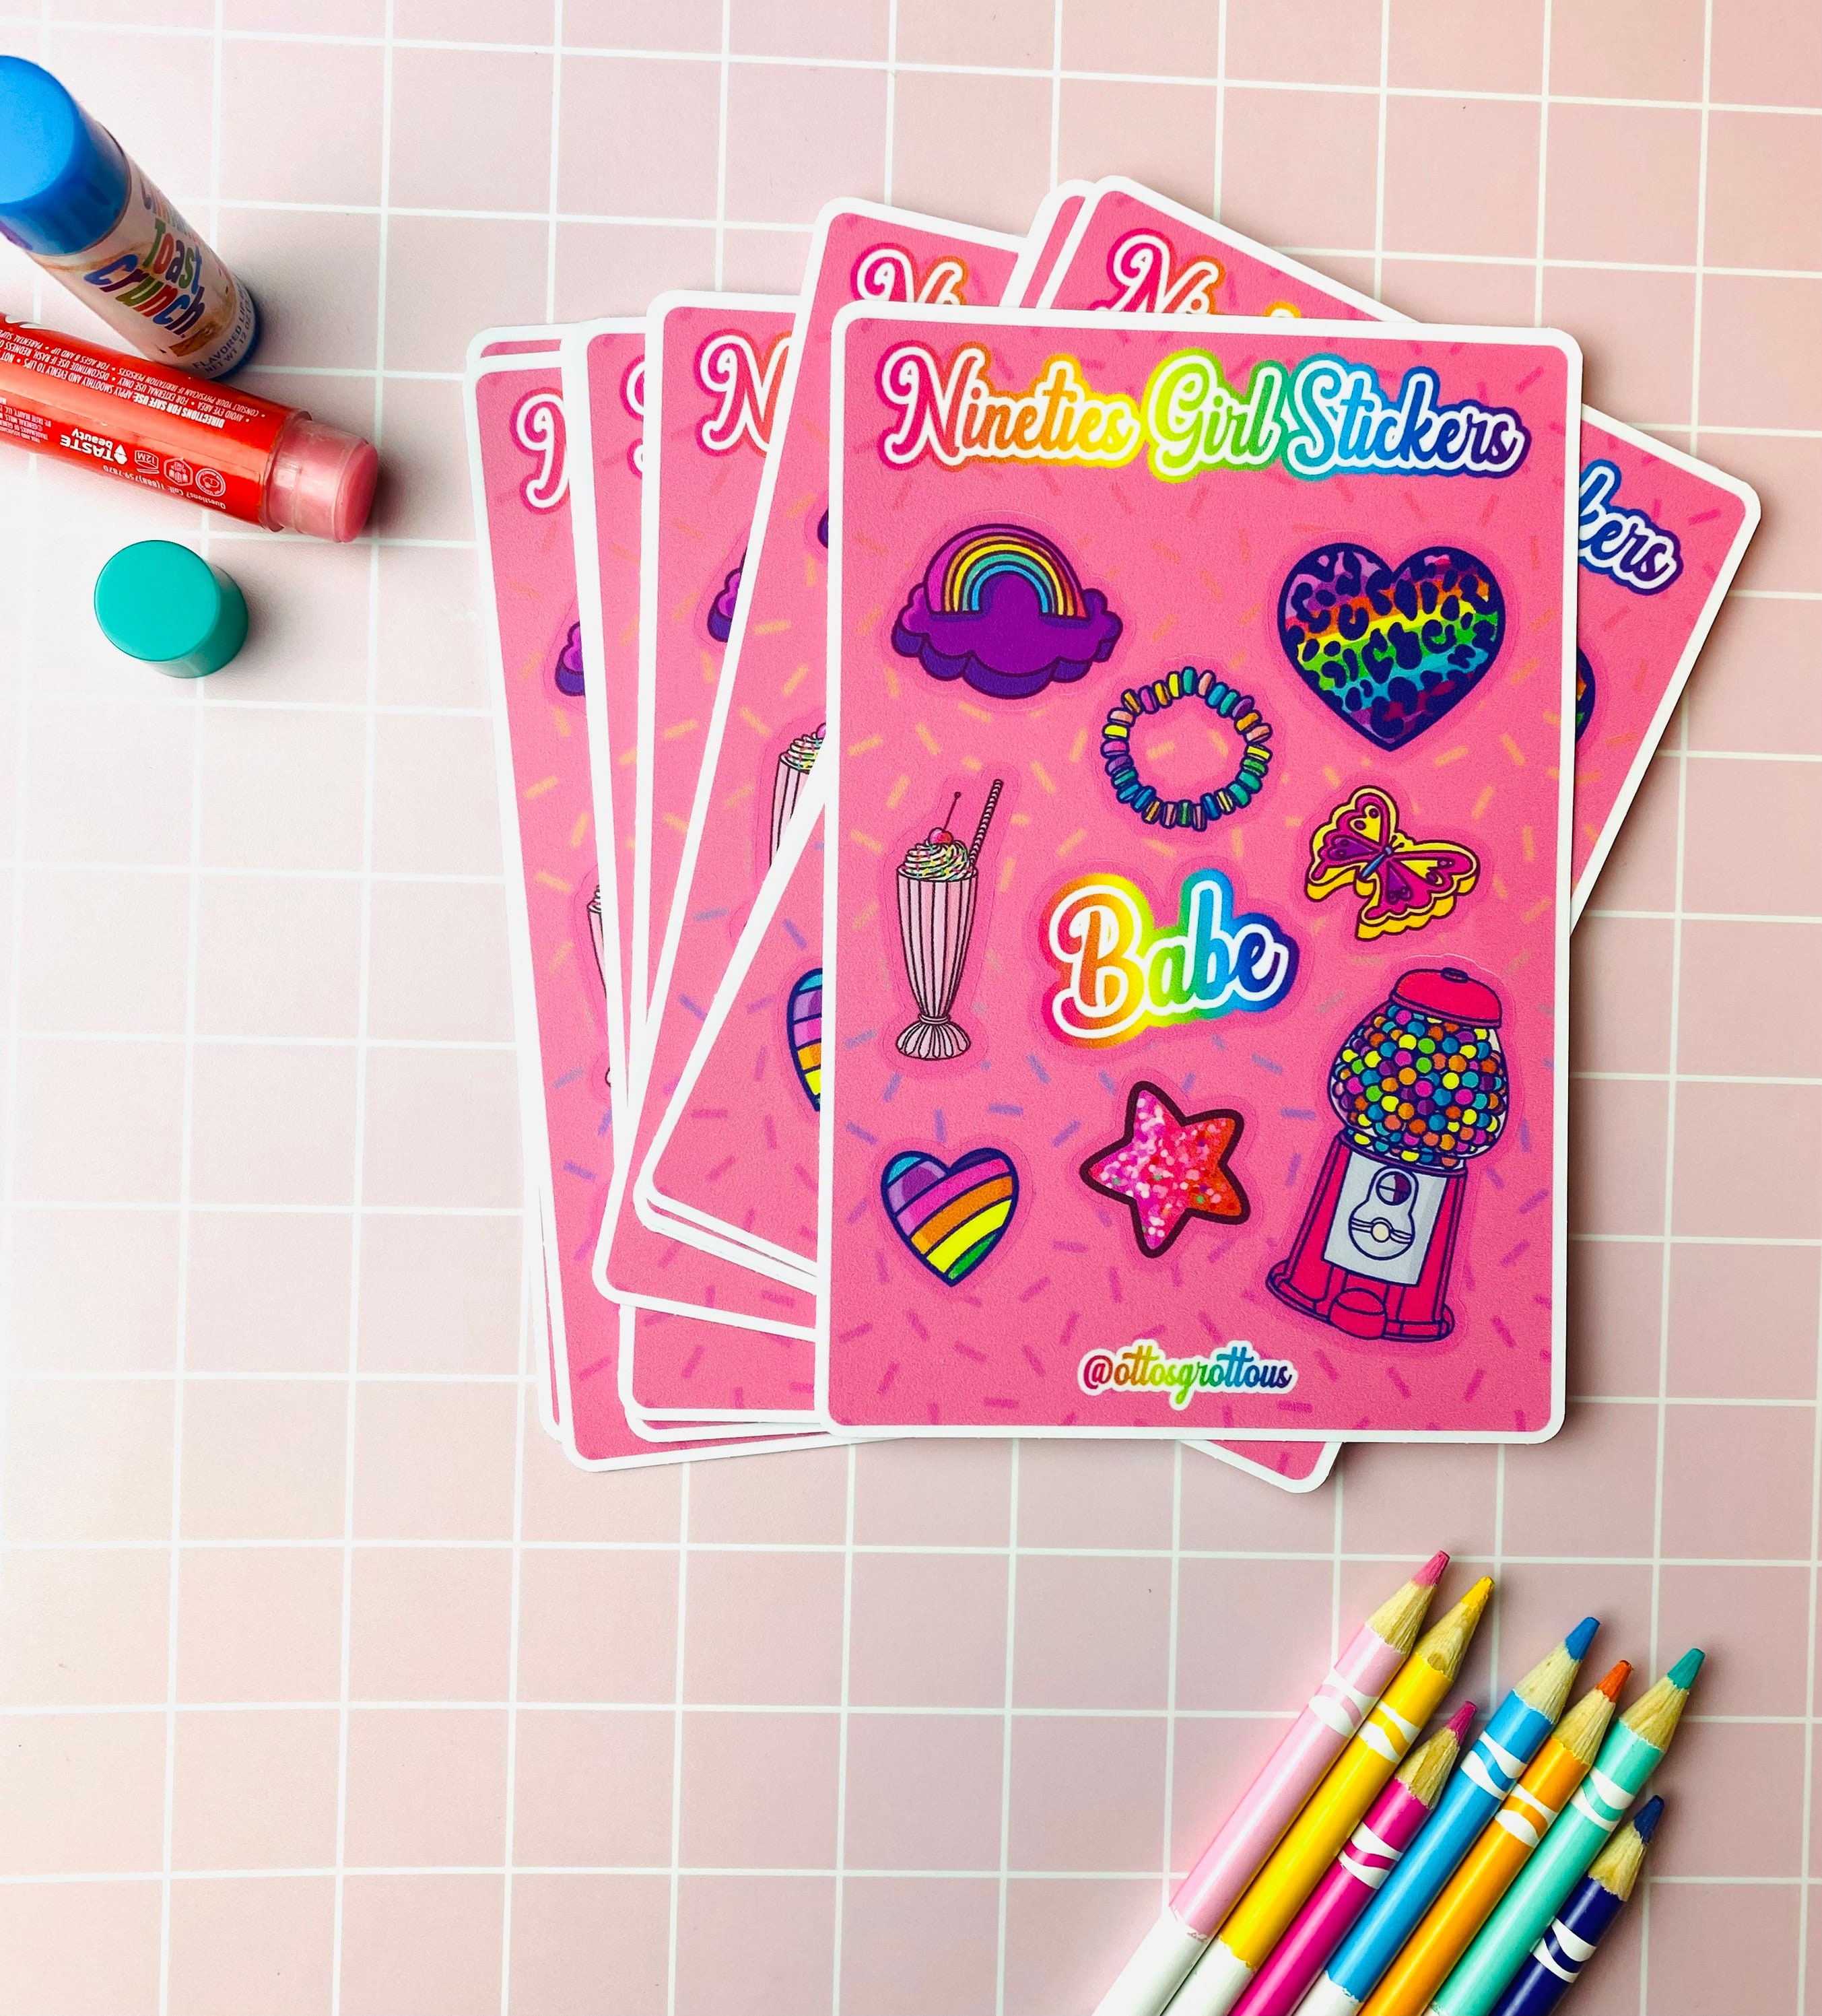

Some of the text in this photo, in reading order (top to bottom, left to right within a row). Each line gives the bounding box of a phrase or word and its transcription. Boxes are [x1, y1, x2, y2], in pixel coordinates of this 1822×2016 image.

[143, 217, 202, 294] Toast
[83, 253, 205, 335] Crunch
[13, 335, 43, 349] PARENTAL
[192, 325, 242, 368] FLAVORED
[4, 342, 32, 356] REDNESS
[33, 349, 50, 362] RASH,
[61, 350, 75, 359] AND
[23, 358, 37, 370] LIPS
[49, 356, 58, 364] IF
[57, 358, 70, 368] USE
[80, 356, 97, 366] AGES
[96, 361, 110, 370] FOR
[36, 363, 46, 373] TO
[46, 366, 68, 379] EVENLY
[70, 362, 109, 380] DISCONTINUE
[118, 368, 145, 381] PERSISTS
[68, 372, 82, 383] AND
[117, 378, 134, 388] ONLY
[145, 377, 178, 391] IRRITATION
[81, 377, 114, 393] SMOOTHLY
[134, 382, 147, 393] USE
[113, 387, 133, 399] APPLY
[147, 386, 176, 401] EXTERNAL
[184, 389, 215, 403] PHYSICIAN
[148, 397, 167, 410] SAFE
[176, 395, 189, 405] FOR
[215, 399, 232, 408] YOUR
[166, 403, 182, 415] FOR
[197, 402, 213, 412] AREA
[213, 407, 225, 416] EYE
[232, 404, 259, 416] CONSULT
[883, 345, 1139, 467] Nineties
[1147, 354, 1282, 477] Girl
[1287, 358, 1524, 474] Stickers
[182, 408, 224, 428] DIRECTIONS
[225, 411, 244, 422] AVOID
[71, 428, 113, 450] beauty
[60, 434, 114, 462] TASTE
[137, 451, 156, 463] 12M
[187, 492, 226, 509] Questions?
[1048, 884, 1289, 1039] Babe
[1081, 1344, 1292, 1405] @ottosgrottous
